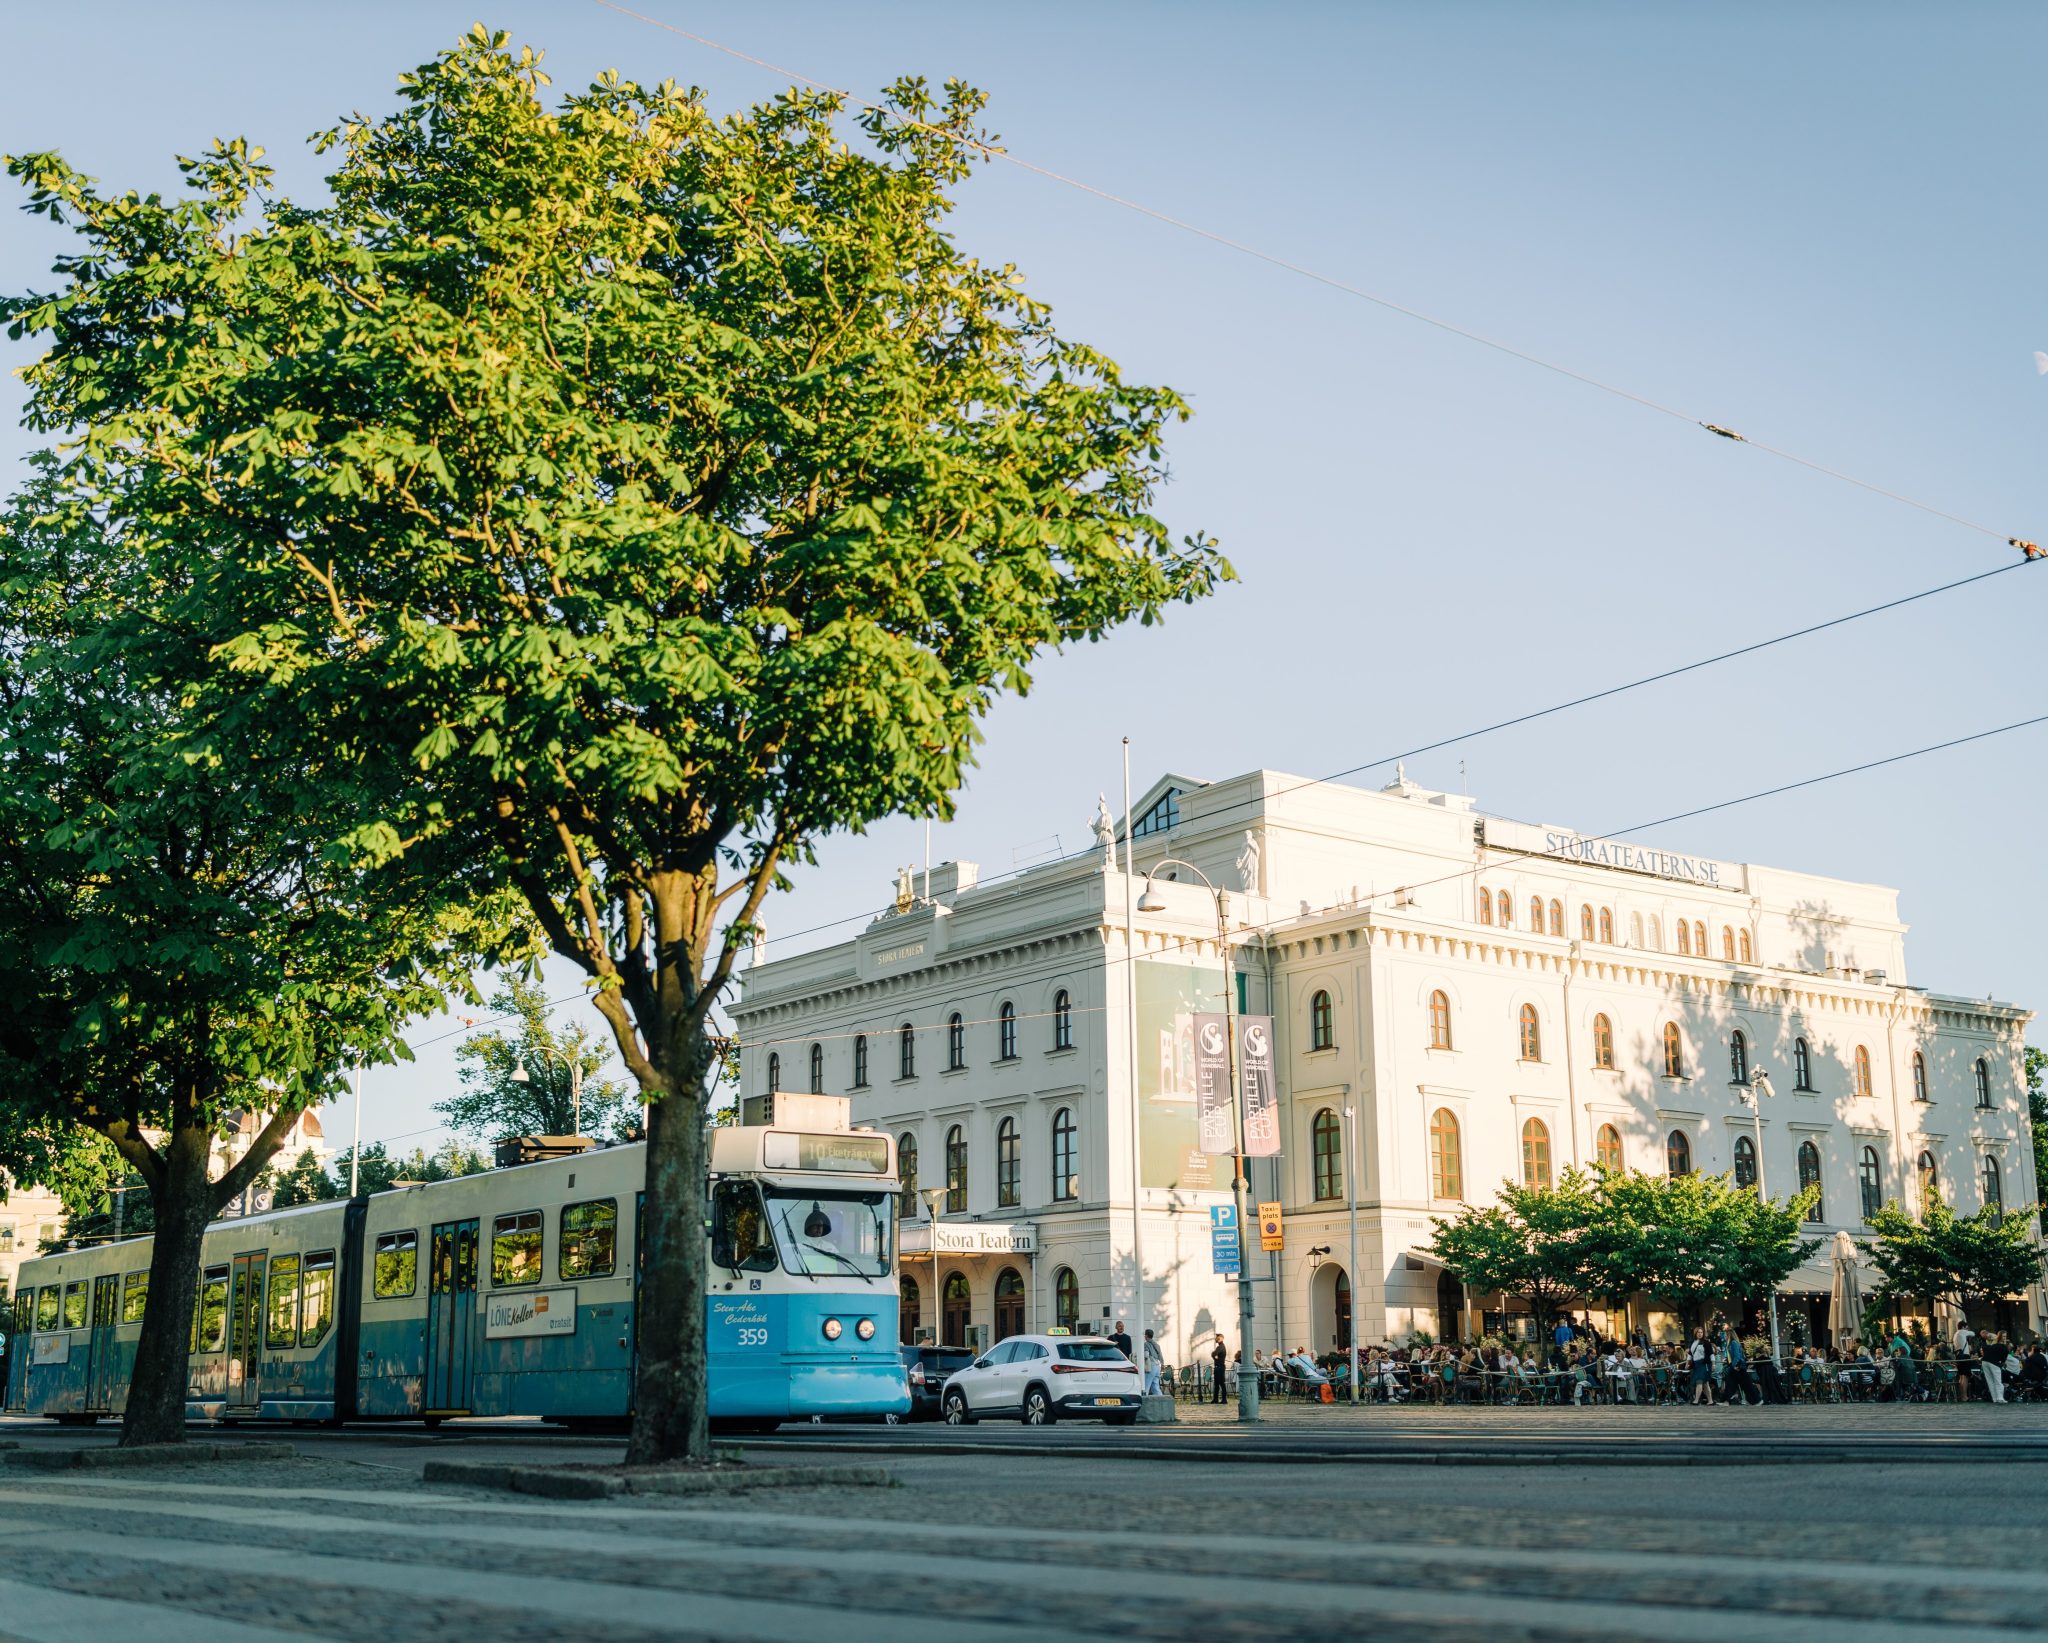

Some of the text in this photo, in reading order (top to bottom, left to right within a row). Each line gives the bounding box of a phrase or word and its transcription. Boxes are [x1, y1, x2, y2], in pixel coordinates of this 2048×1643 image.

[1546, 832, 1719, 883] STORATEATERN.SE
[1201, 1071, 1216, 1138] PARTILLE
[1245, 1073, 1261, 1139] PARTILLE
[1214, 1105, 1227, 1138] CUP
[1259, 1107, 1272, 1139] CUP
[809, 1143, 825, 1160] 10
[1217, 1207, 1231, 1226] P
[937, 1230, 1031, 1249] Stora Teatern
[713, 1299, 757, 1313] Sten-Åke
[724, 1313, 768, 1325] Cederhök
[737, 1328, 768, 1346] 359
